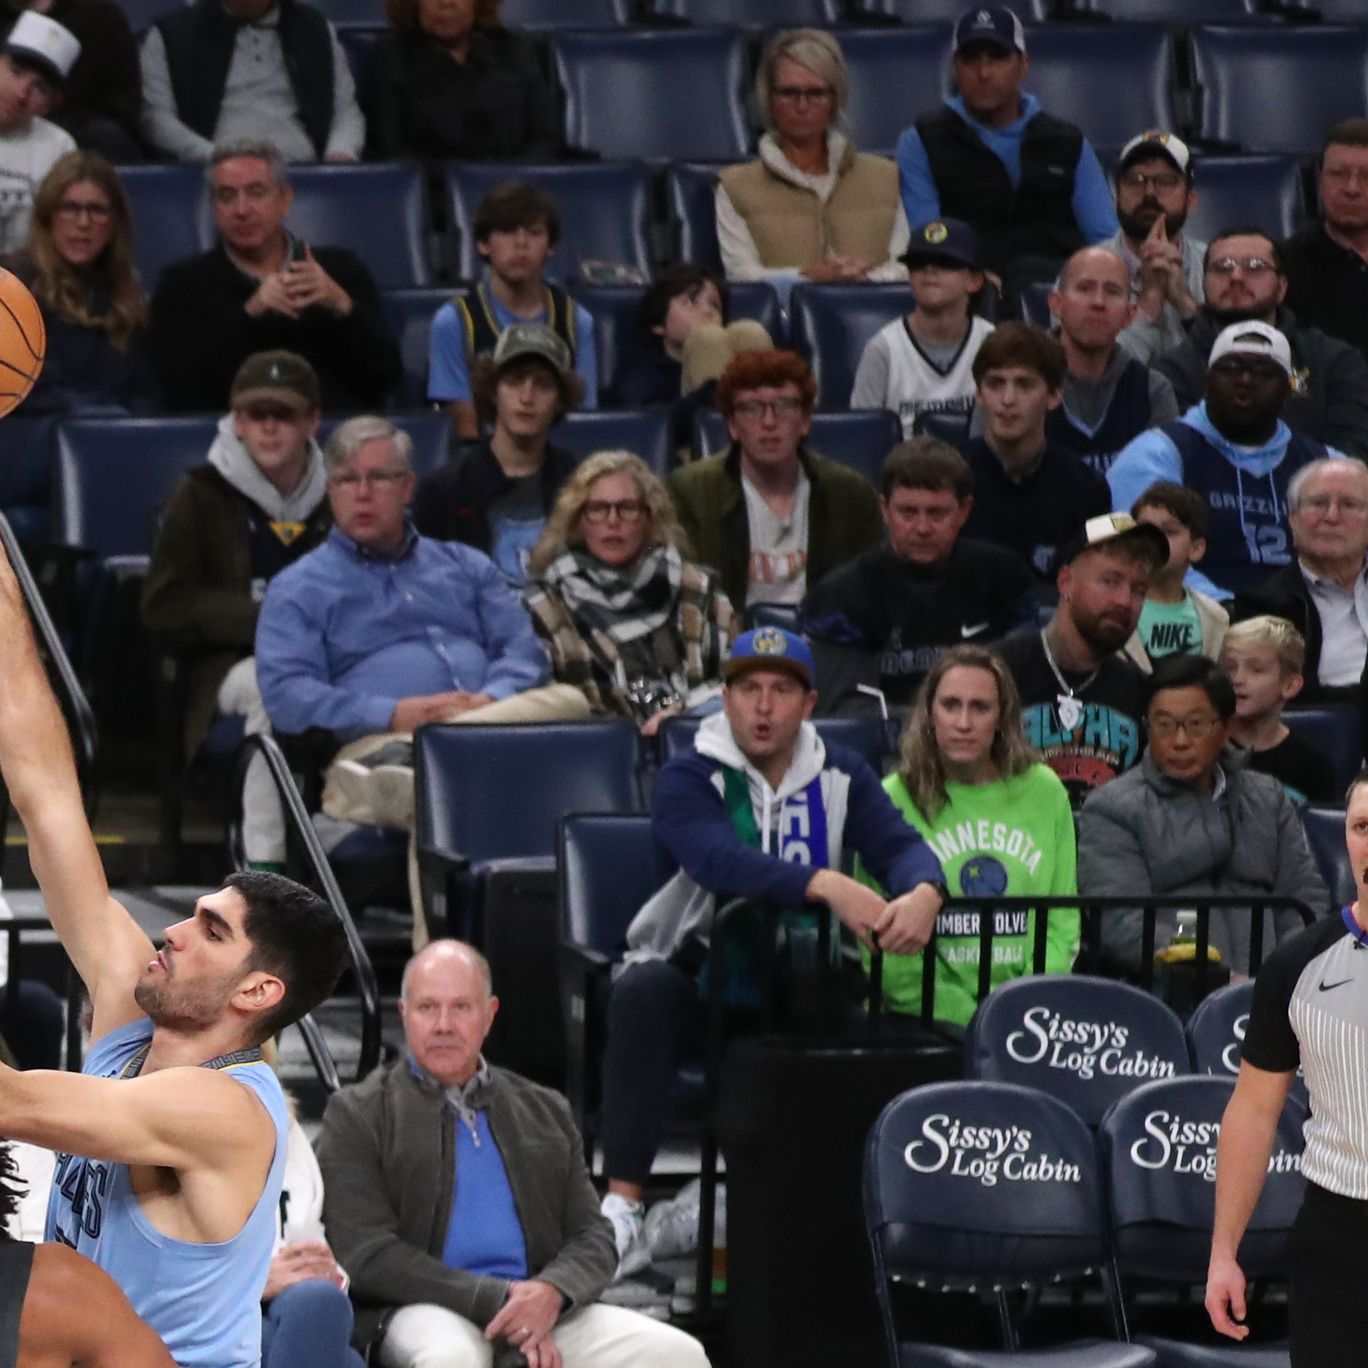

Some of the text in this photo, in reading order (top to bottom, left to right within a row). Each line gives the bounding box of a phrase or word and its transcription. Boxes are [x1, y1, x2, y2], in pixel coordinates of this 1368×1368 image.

[1150, 623, 1194, 650] NIKE
[927, 819, 1043, 877] INNESOTA
[1006, 1006, 1129, 1065] Sissy's
[1049, 1043, 1176, 1079] Log Cabin
[904, 1113, 1032, 1174] Sissy's
[951, 1151, 1081, 1187] Log Cabin
[1130, 1110, 1220, 1170] Siss
